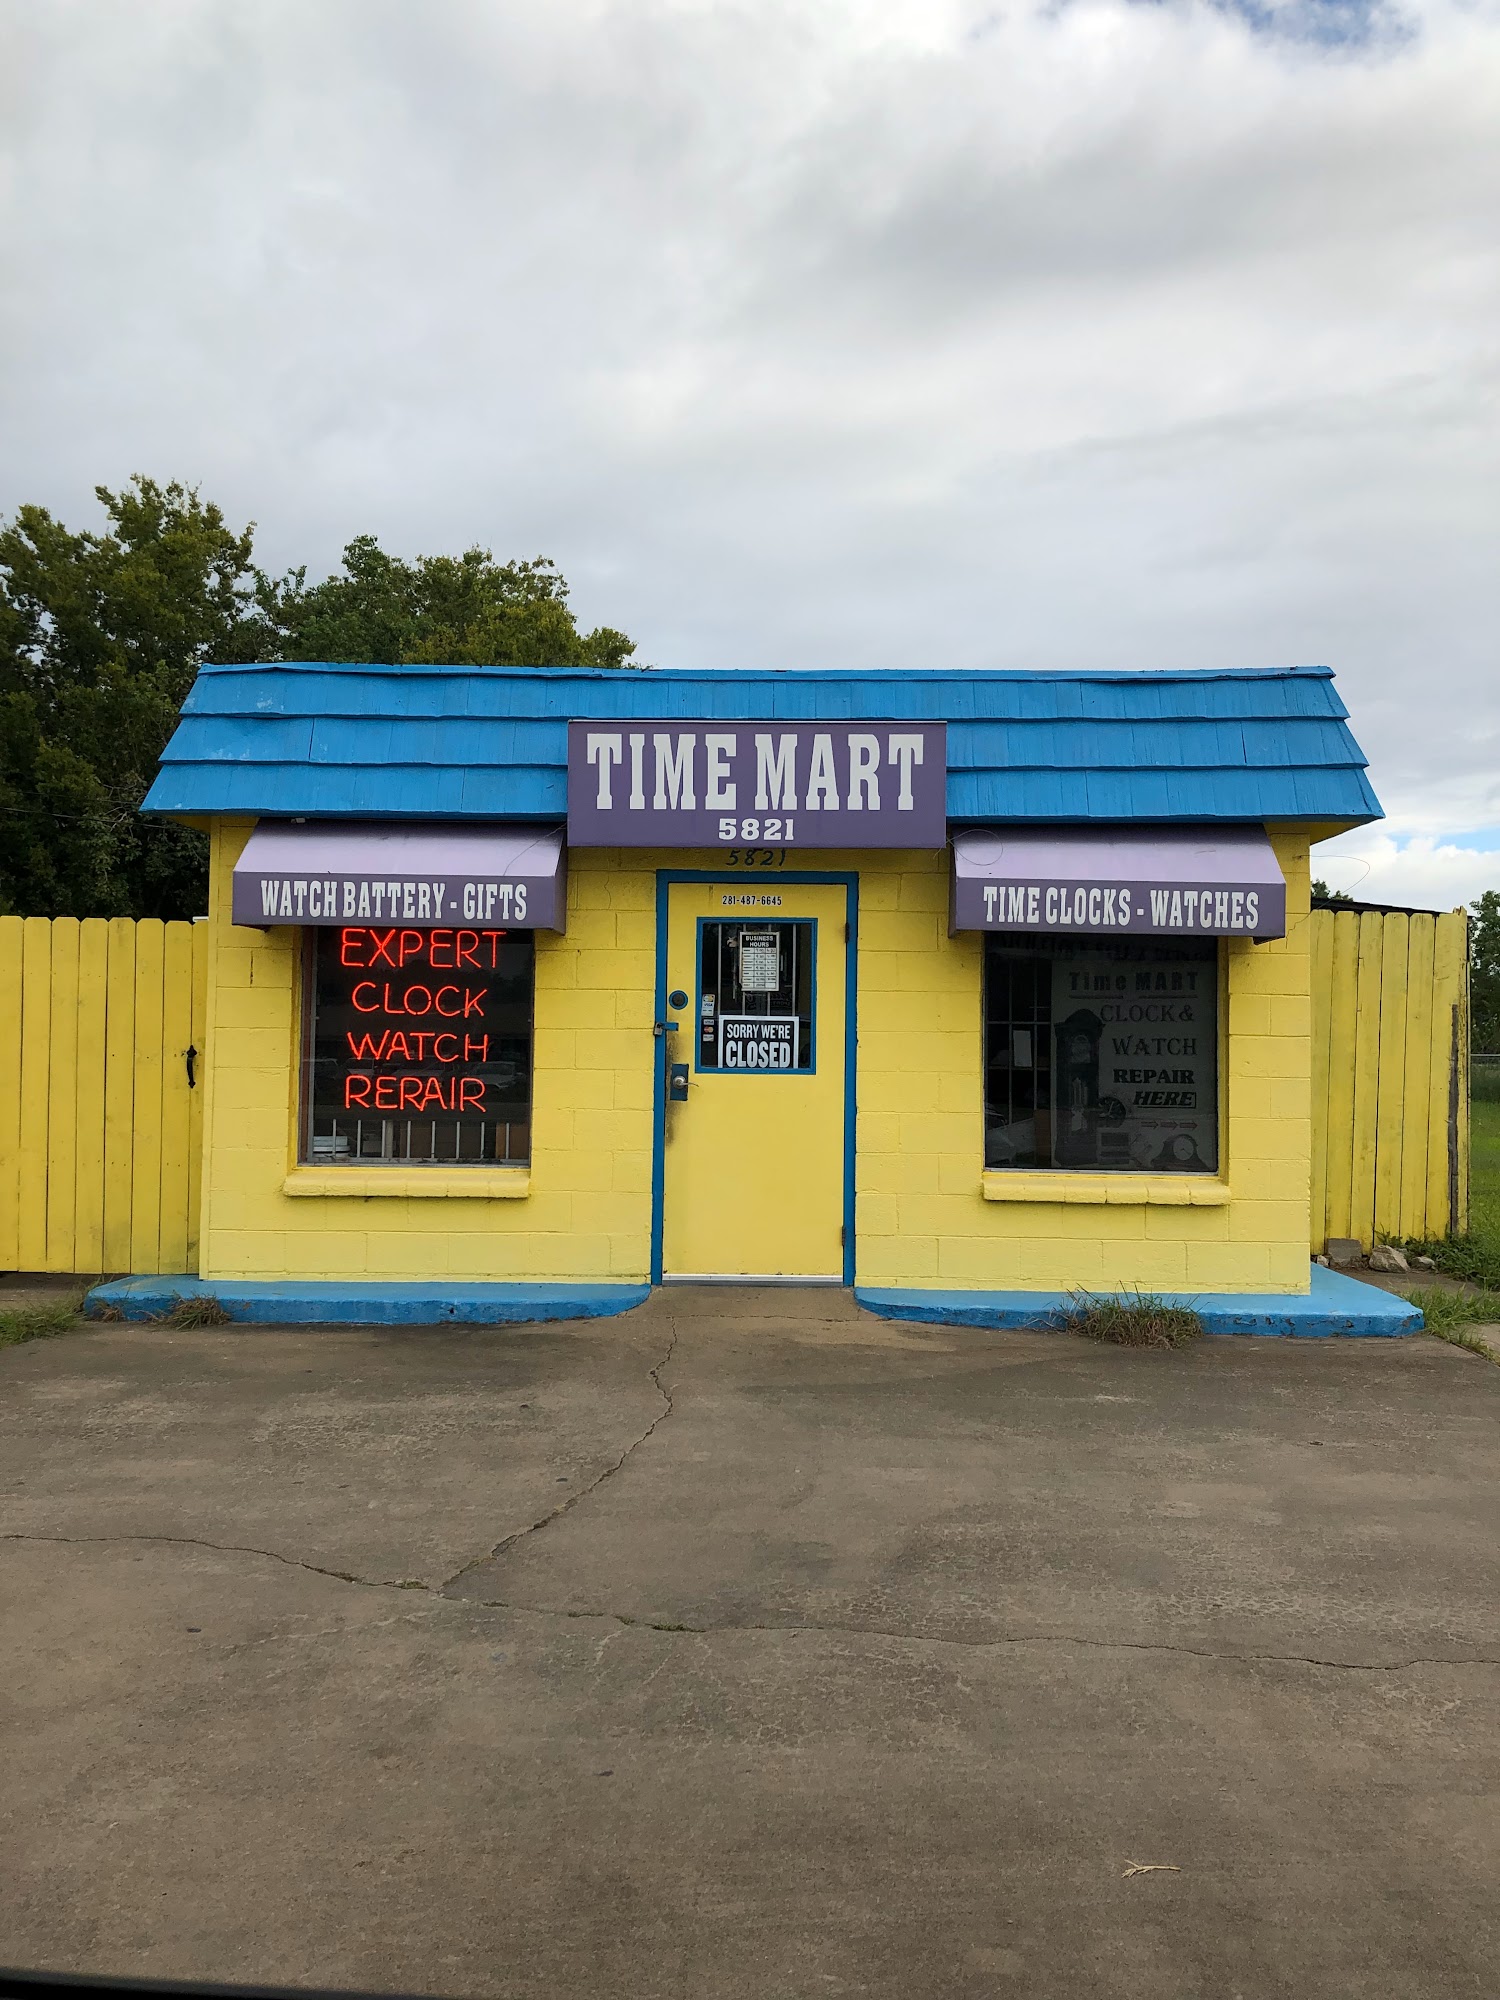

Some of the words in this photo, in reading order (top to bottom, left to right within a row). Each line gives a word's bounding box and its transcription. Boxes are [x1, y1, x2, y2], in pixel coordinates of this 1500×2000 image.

[587, 733, 737, 810] TIME
[754, 733, 924, 811] MART
[718, 818, 794, 841] 5821
[725, 847, 787, 867] 5821
[261, 880, 338, 917] WATCH
[342, 881, 446, 919] BATTERY
[463, 883, 527, 921] GIFTS
[722, 895, 782, 906] 281-487-6645
[983, 886, 1040, 923] TIME
[1045, 887, 1131, 926] CLOCKS
[1150, 890, 1259, 929] WATCHES
[341, 928, 506, 969] EXPERT
[1135, 971, 1198, 991] MART
[352, 982, 488, 1018] CLOCK
[726, 1023, 759, 1039] SORRY
[760, 1024, 791, 1039] WE'RE
[347, 1029, 489, 1062] WATCH
[725, 1040, 791, 1068] CLOSED
[1112, 1035, 1197, 1056] WATCH
[1113, 1069, 1195, 1085] REPAIR
[1132, 1091, 1194, 1107] HERE
